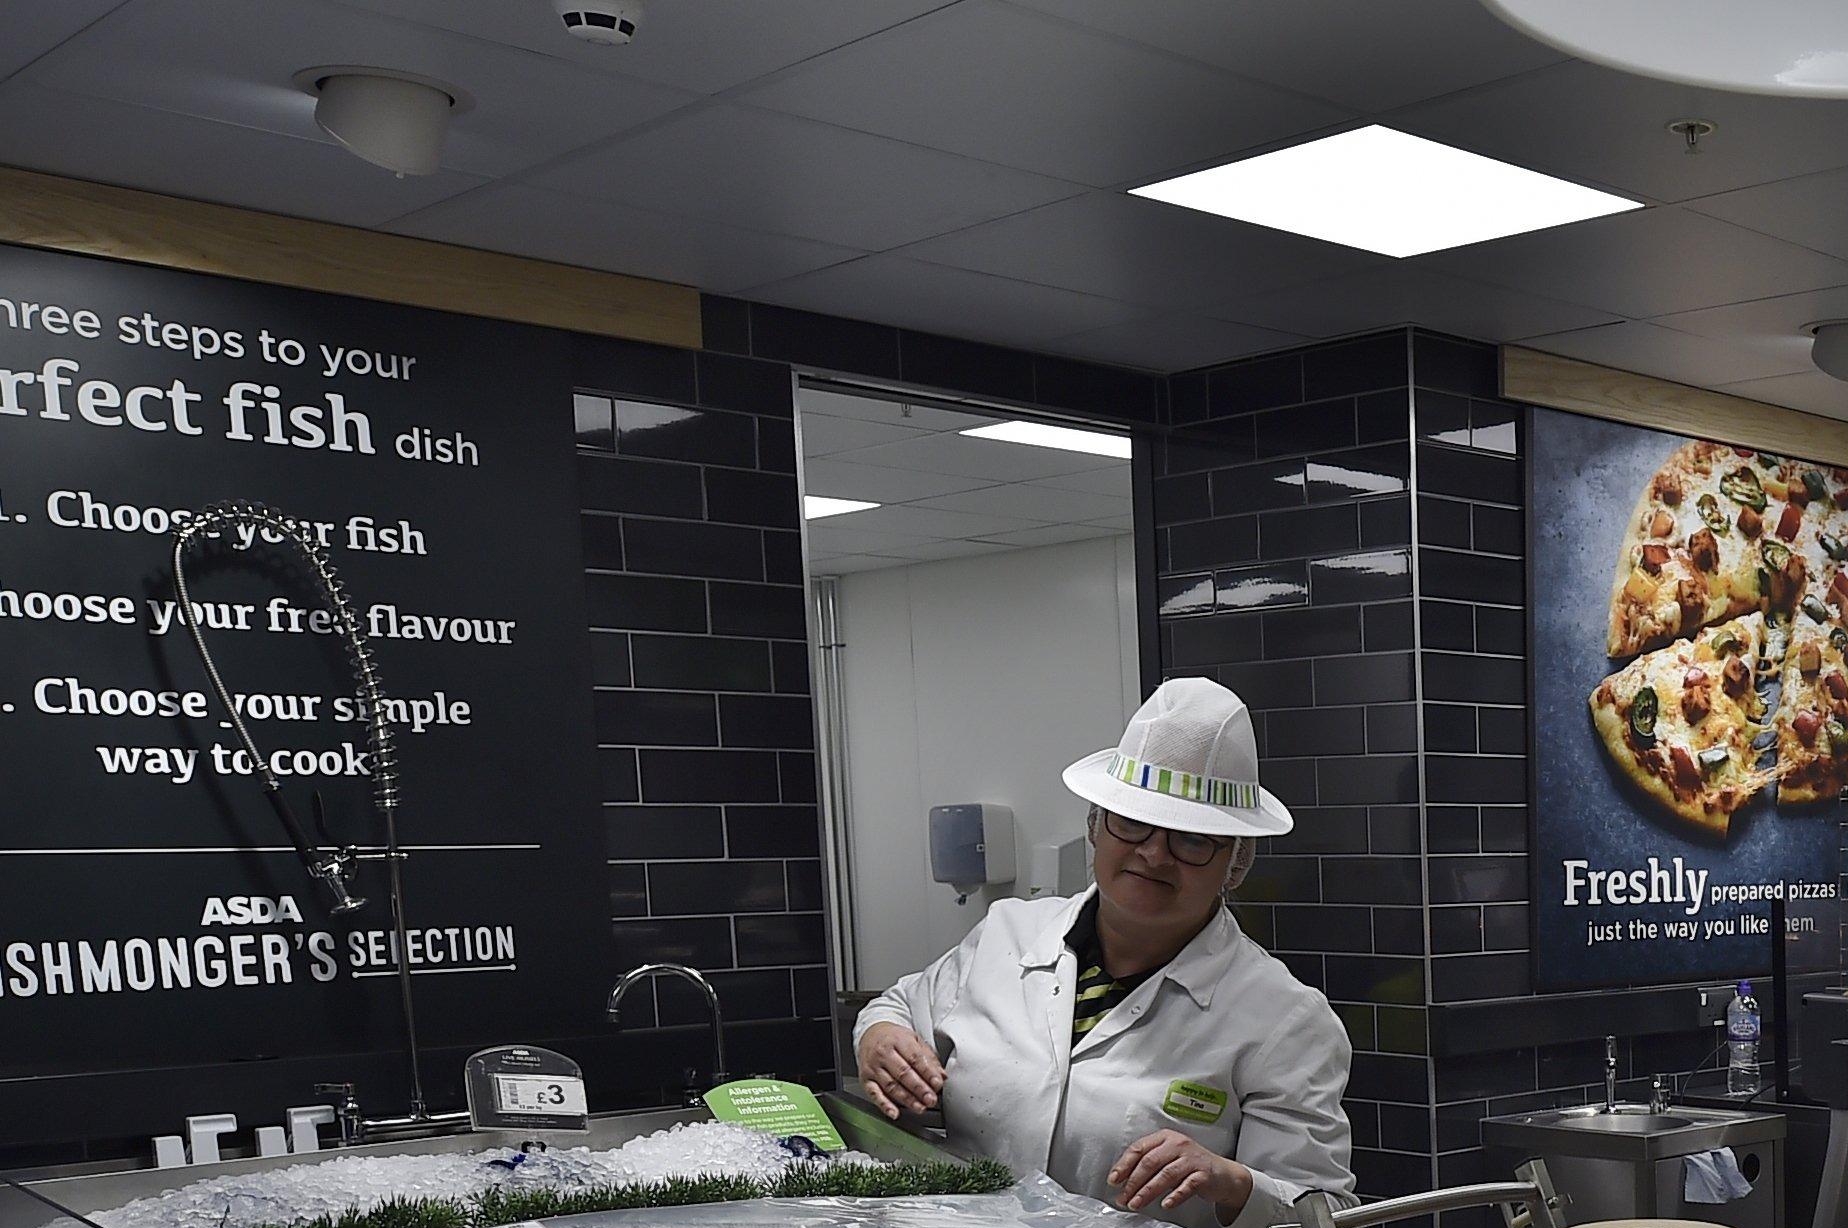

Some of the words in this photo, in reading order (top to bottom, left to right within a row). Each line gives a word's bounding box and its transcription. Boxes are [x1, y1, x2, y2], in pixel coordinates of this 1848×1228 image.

[118, 313, 246, 360] steps
[258, 329, 306, 366] to
[319, 344, 417, 381] your
[222, 381, 377, 455] fish
[395, 427, 480, 466] dish
[346, 516, 427, 555] fish
[366, 604, 516, 644] flavour
[34, 677, 208, 718] Choose
[97, 747, 199, 784] way
[211, 743, 255, 775] to
[270, 743, 373, 776] cook
[1563, 857, 1708, 915] Freshly
[1711, 880, 1784, 905] prepared
[1788, 880, 1836, 901] pizzas
[201, 896, 304, 925] ASDA
[1587, 921, 1622, 945] just
[1628, 919, 1658, 940] the
[1664, 921, 1698, 941] way
[1704, 919, 1735, 940] you
[1740, 915, 1769, 935] like
[0, 931, 338, 998] SHMONGER'S
[537, 1084, 566, 1105] £3
[728, 1085, 772, 1096] Allergen
[731, 1094, 789, 1106] Intolerance
[737, 1102, 798, 1115] Information
